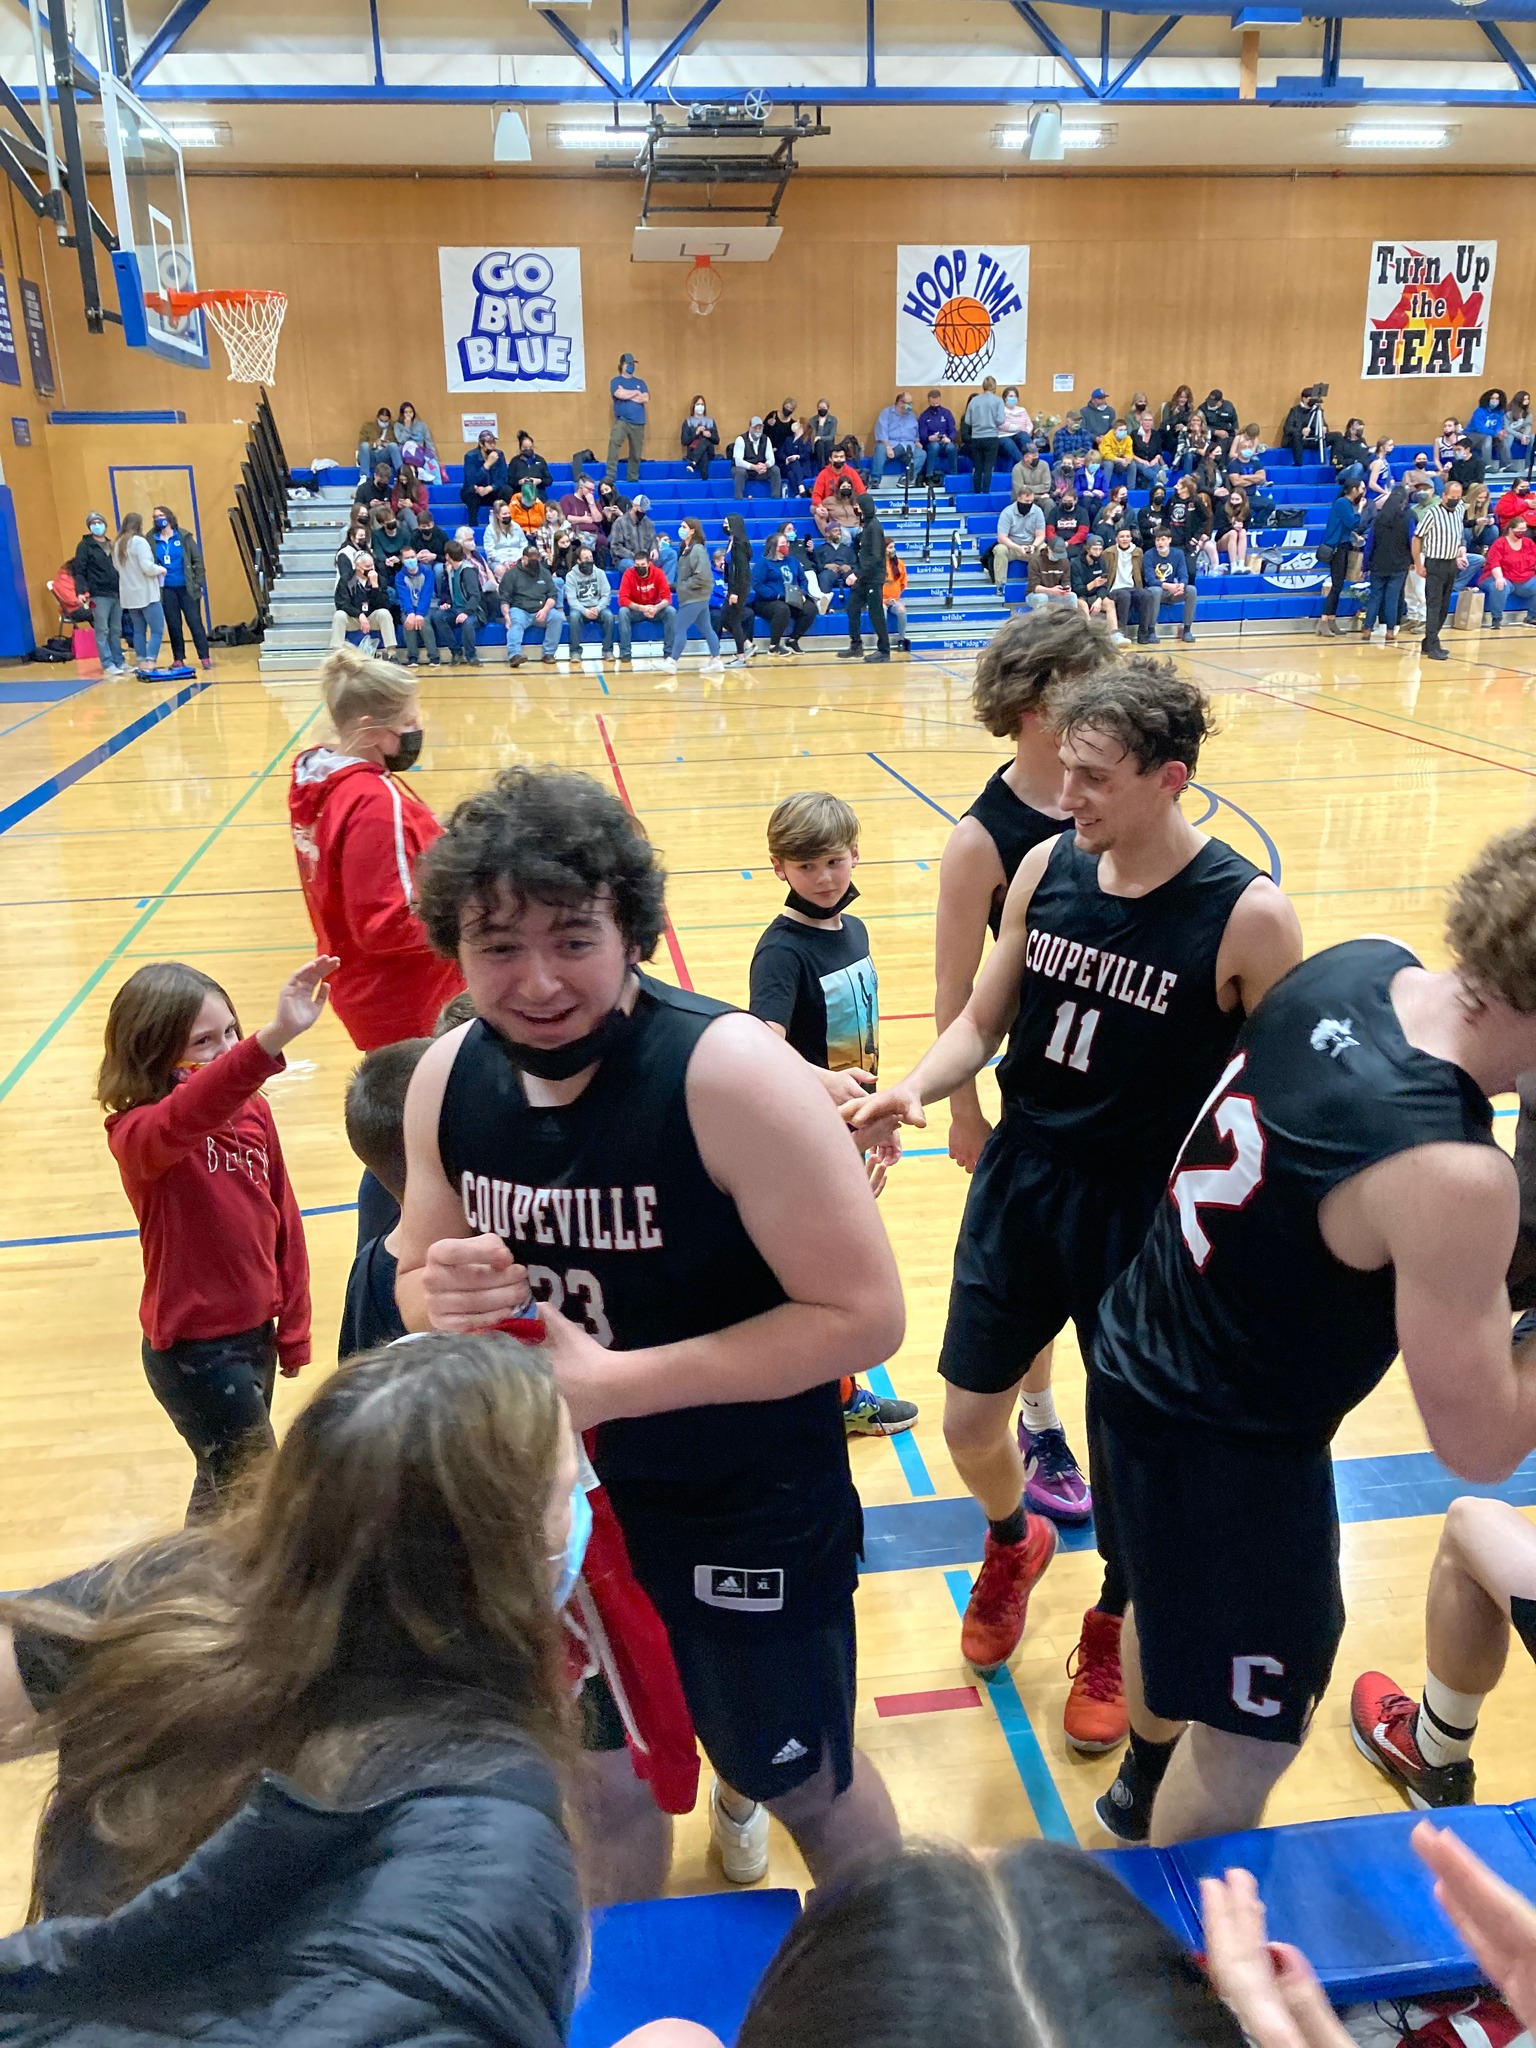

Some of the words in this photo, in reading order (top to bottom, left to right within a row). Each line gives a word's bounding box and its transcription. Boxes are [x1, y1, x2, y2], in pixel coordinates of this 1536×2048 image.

[473, 251, 554, 293] GO
[902, 249, 967, 325] HOOP
[973, 252, 1023, 324] TIME
[1376, 245, 1441, 285] Turn
[1456, 244, 1490, 292] Up
[474, 294, 556, 334] BIG
[1411, 291, 1446, 318] the
[458, 335, 572, 382] BLUE
[1366, 328, 1483, 376] HEAT
[1025, 928, 1178, 1015] COUPEVILLE
[1044, 1000, 1101, 1073] 11
[461, 1170, 664, 1250] COUPEVILLE
[1231, 1655, 1284, 1718] C
